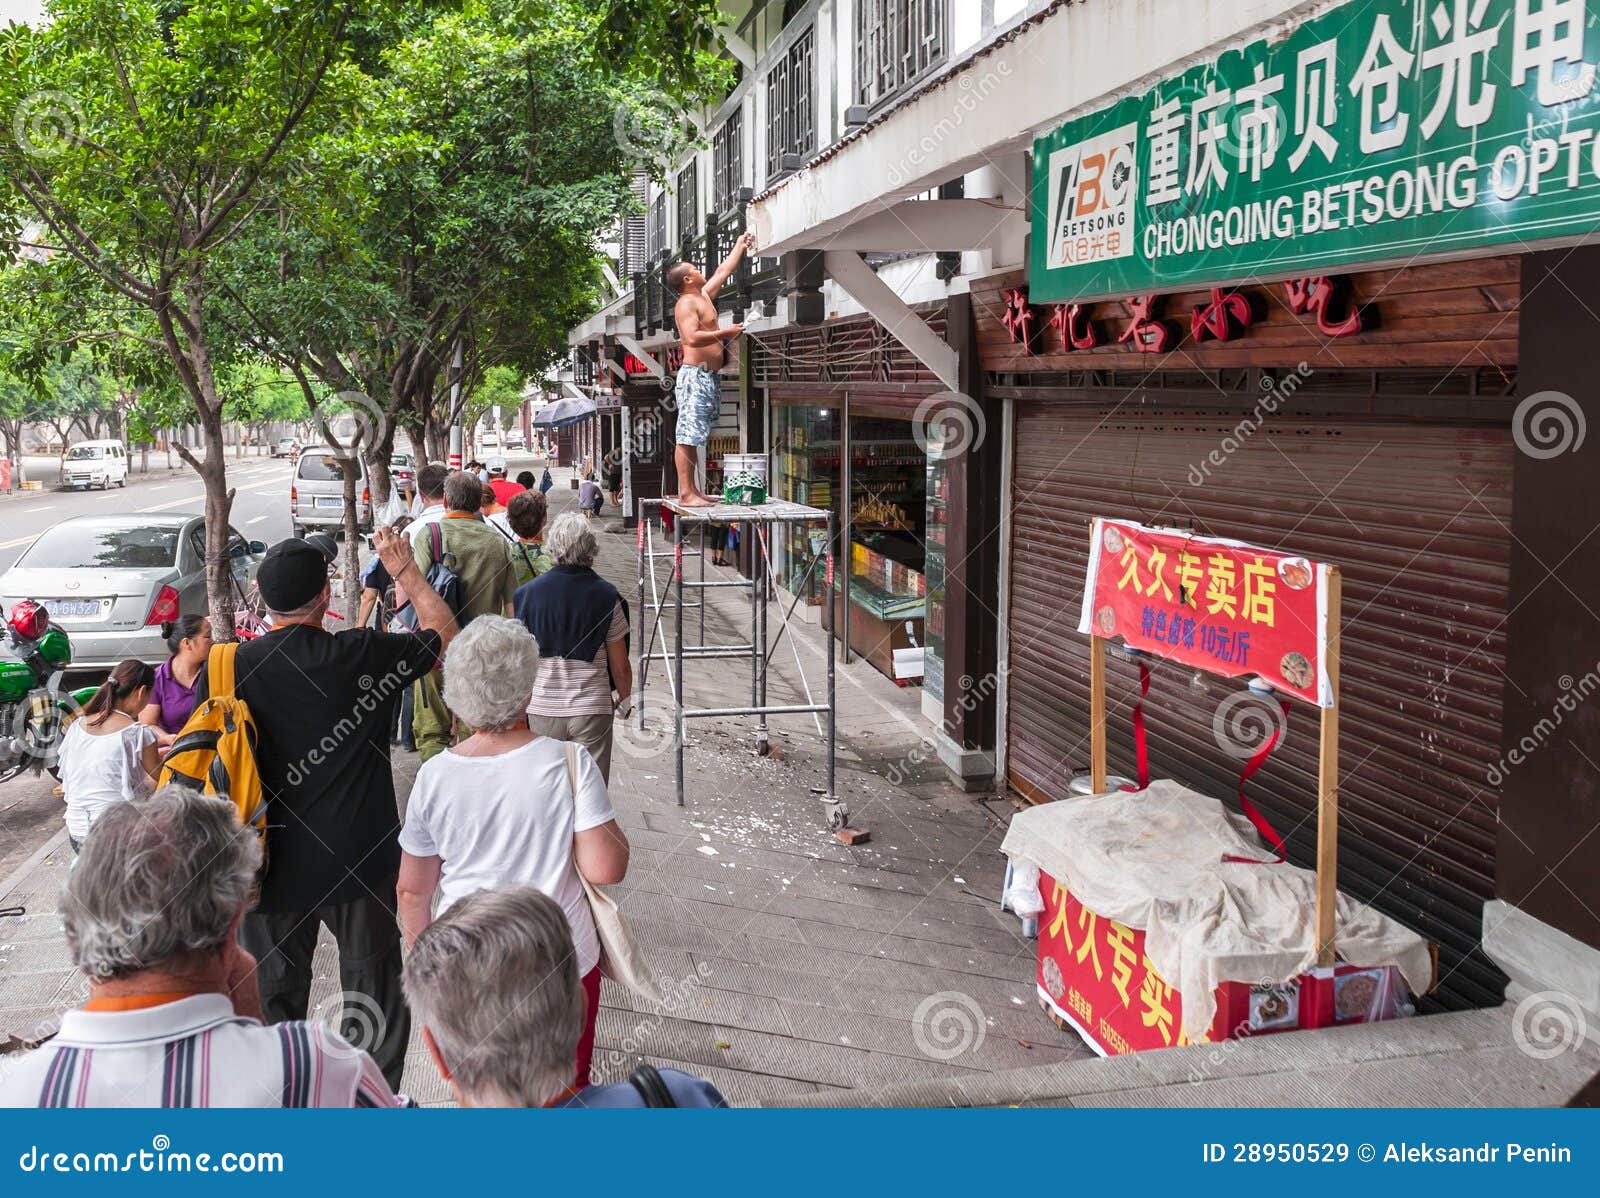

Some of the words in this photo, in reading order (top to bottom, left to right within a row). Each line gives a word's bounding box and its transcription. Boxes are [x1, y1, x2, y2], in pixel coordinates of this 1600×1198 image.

[1063, 211, 1126, 238] BETSONG
[1144, 194, 1294, 260] CHONGQING
[1302, 155, 1478, 233] BETSONG
[1492, 128, 1600, 201] OPT
[1061, 230, 1121, 264] 贝仓光电
[1117, 537, 1277, 628] 久久专卖店
[1050, 880, 1213, 1047] 久久专卖
